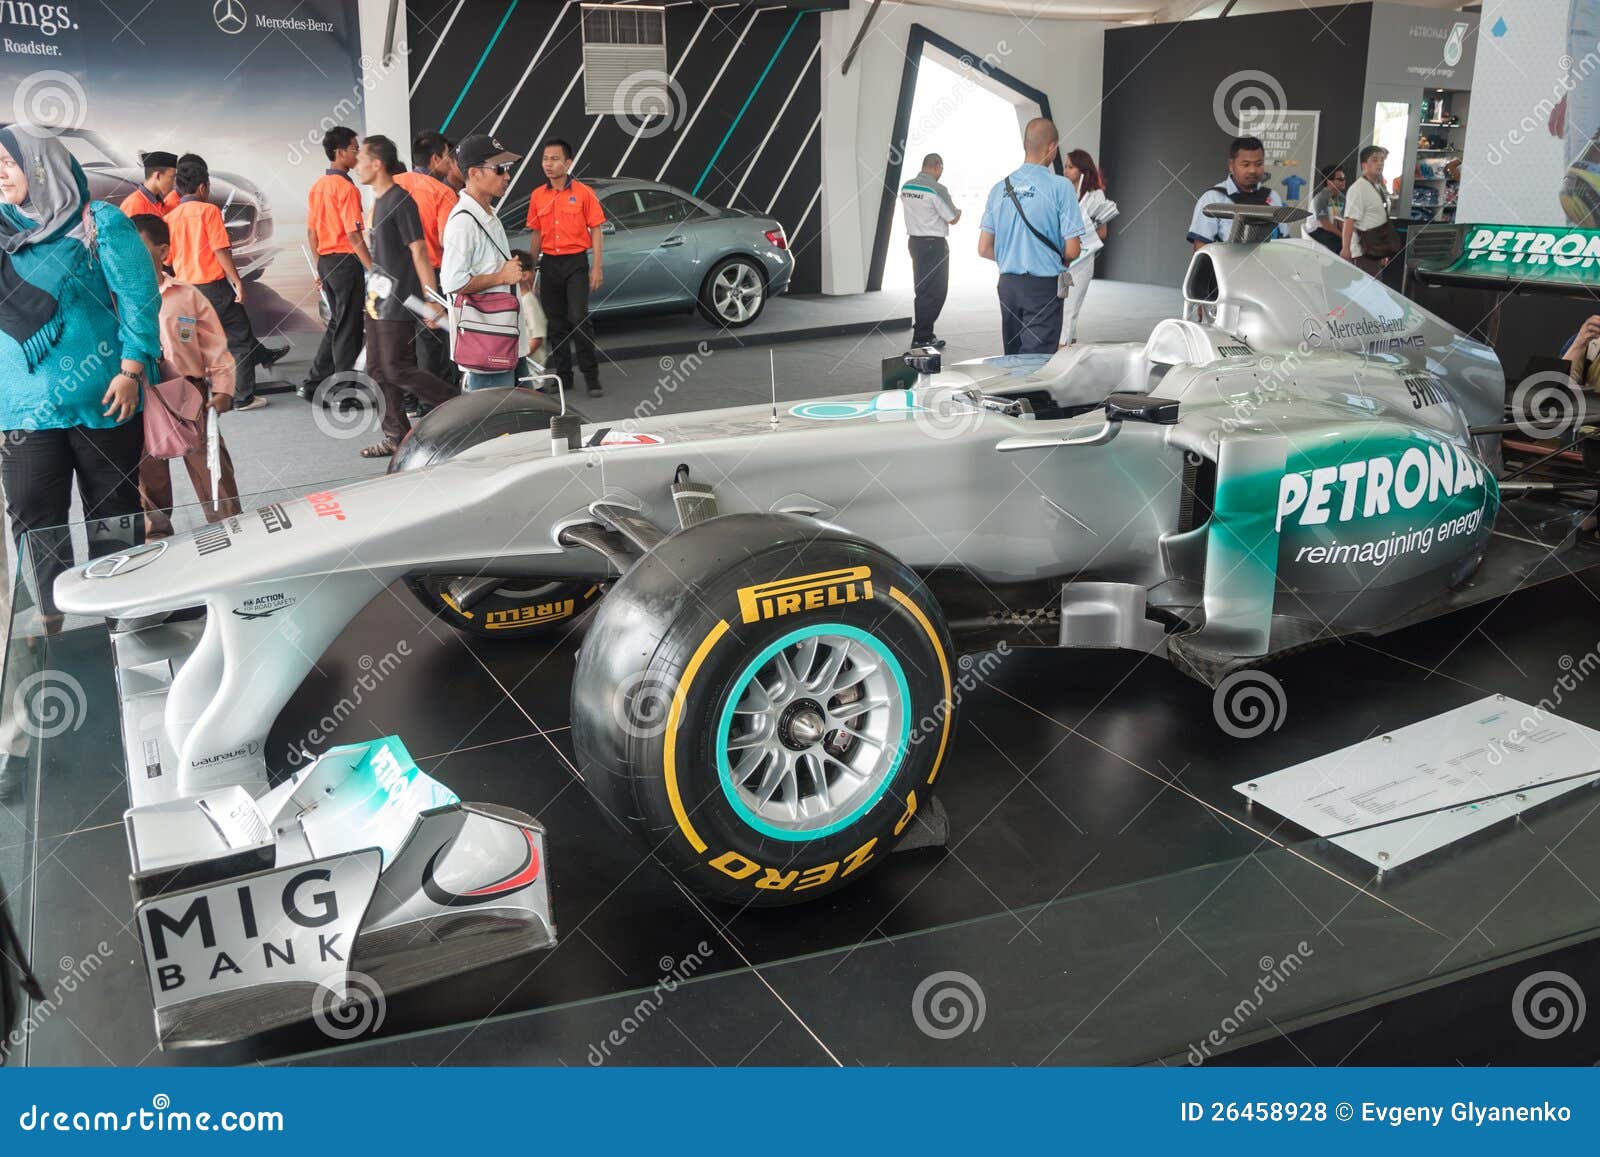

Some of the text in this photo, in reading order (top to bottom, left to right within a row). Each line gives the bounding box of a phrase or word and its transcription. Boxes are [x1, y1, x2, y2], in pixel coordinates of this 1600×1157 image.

[0, 0, 79, 36] ings.
[255, 14, 333, 33] Mercedes-Benz
[3, 38, 62, 56] Roadster.
[1327, 315, 1405, 340] Mercedes-Benz
[1295, 506, 1484, 567] reimagining energy
[256, 593, 284, 605] ACTION
[736, 565, 875, 624] PIRELLI
[485, 599, 574, 630] PIRELLI
[708, 837, 878, 892] ZERO
[146, 869, 339, 961] MIG
[157, 933, 345, 992] BANK
